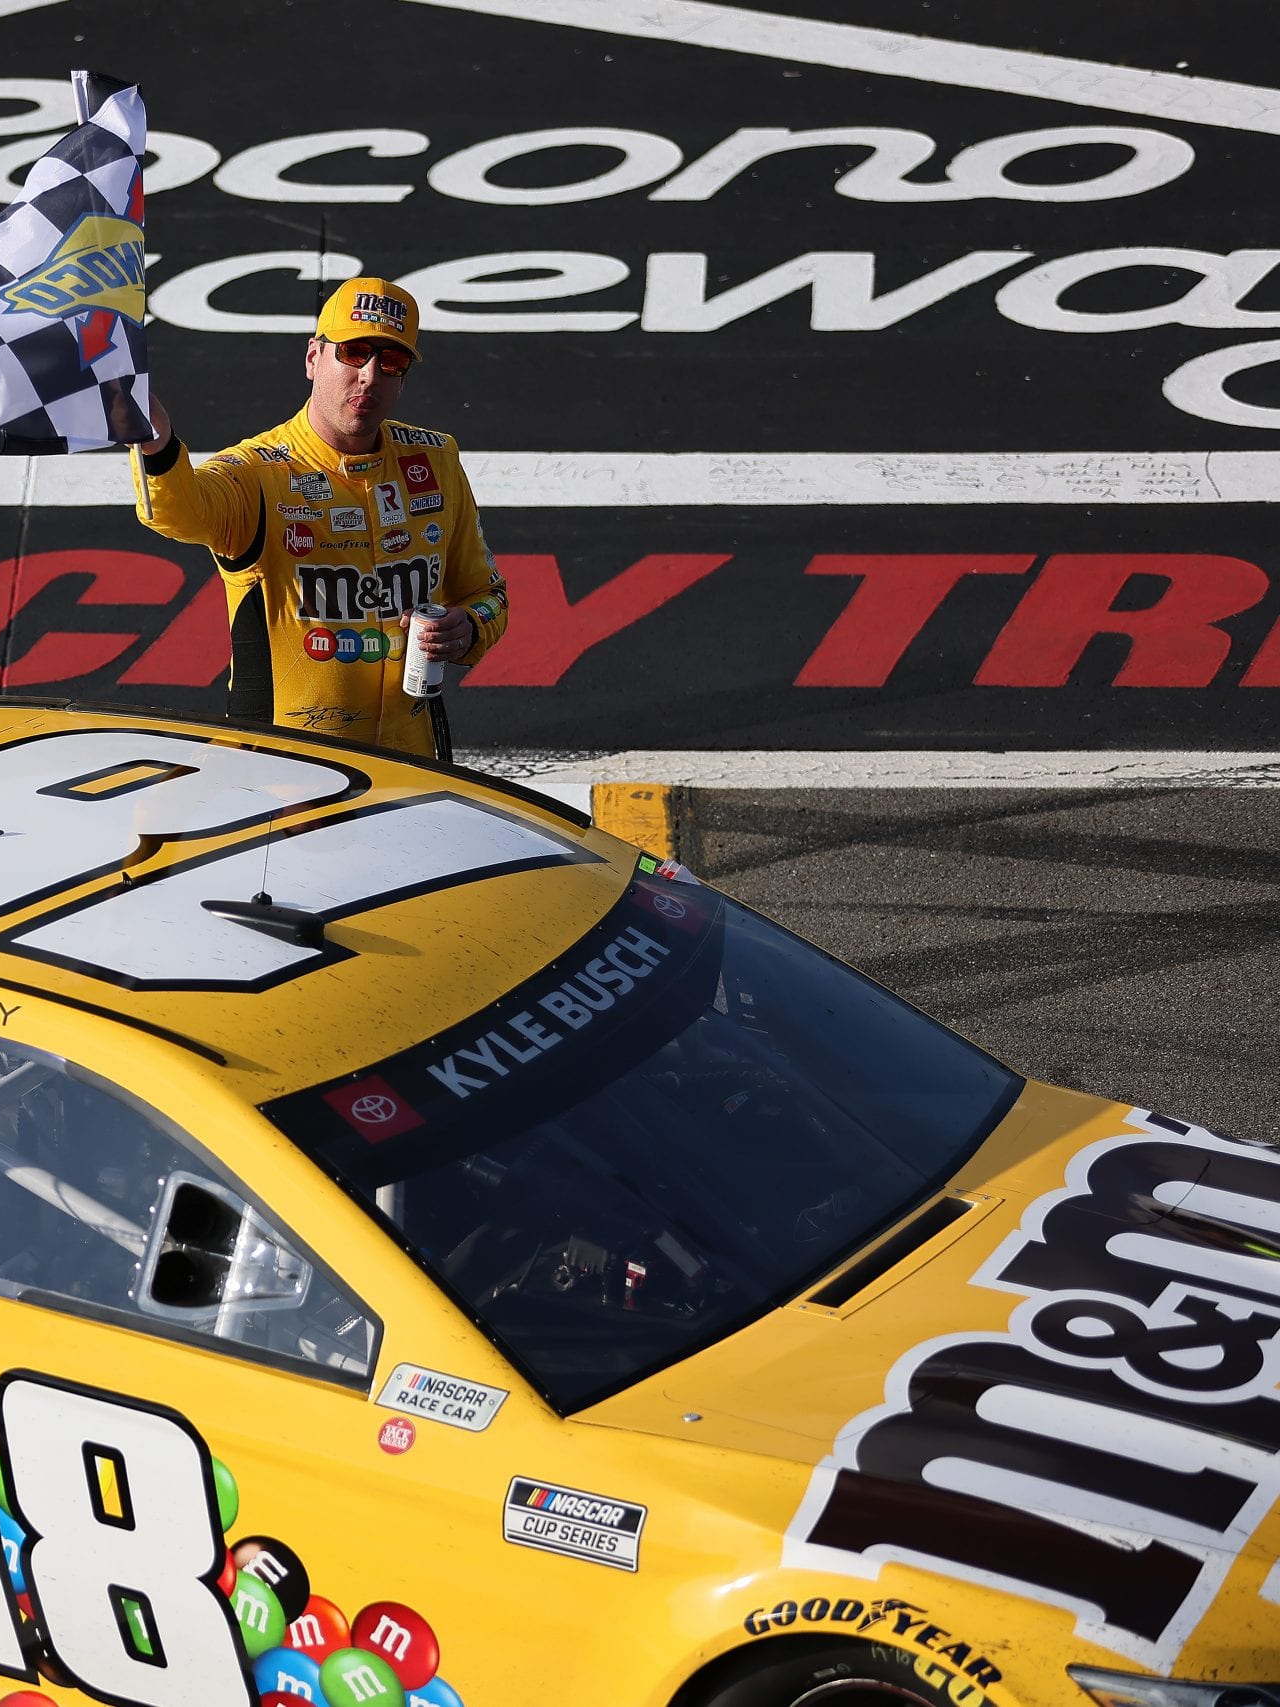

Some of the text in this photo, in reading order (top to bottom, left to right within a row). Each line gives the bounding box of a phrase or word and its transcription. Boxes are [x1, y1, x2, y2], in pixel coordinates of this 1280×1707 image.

[410, 495, 441, 511] SNICKERS
[286, 523, 314, 552] Rheem
[382, 534, 410, 549] Skittles
[298, 556, 440, 621] m&m's
[311, 636, 330, 652] m
[337, 637, 356, 653] m
[361, 636, 380, 652] m
[426, 926, 671, 1099] KYLE BUSCH
[397, 1390, 477, 1422] RACE CAR
[422, 1377, 488, 1407] NASCAR
[548, 1492, 625, 1528] NASCAR
[522, 1516, 619, 1553] CUP SERIES
[235, 1589, 269, 1634] m
[290, 1613, 325, 1648] m
[370, 1614, 413, 1662] m
[342, 1664, 387, 1702] m
